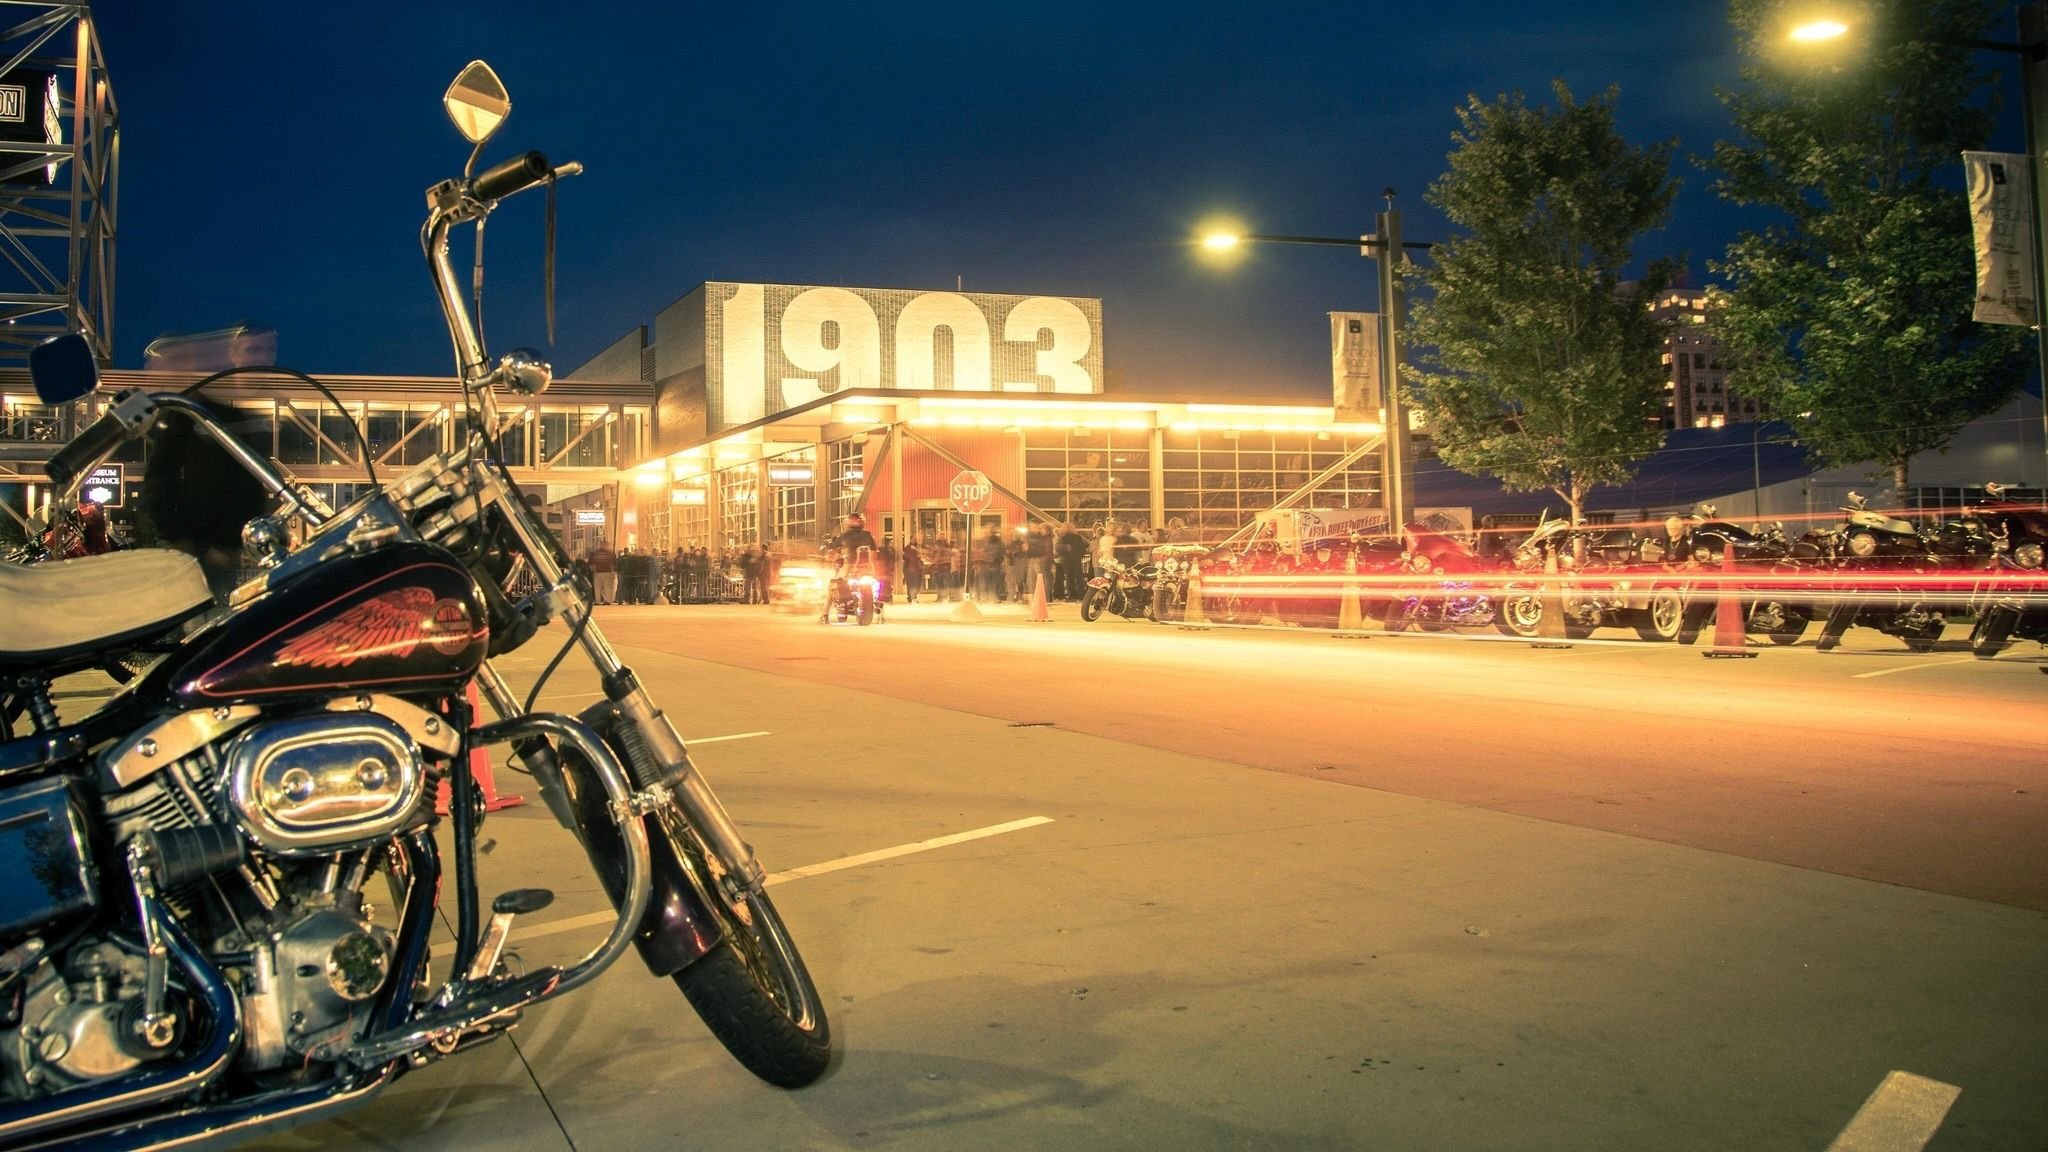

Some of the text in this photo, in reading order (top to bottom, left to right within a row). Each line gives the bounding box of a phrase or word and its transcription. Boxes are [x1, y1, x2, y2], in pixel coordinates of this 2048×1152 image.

[723, 284, 1093, 424] 1903
[85, 477, 120, 485] NTRANCE
[953, 484, 989, 501] STOP
